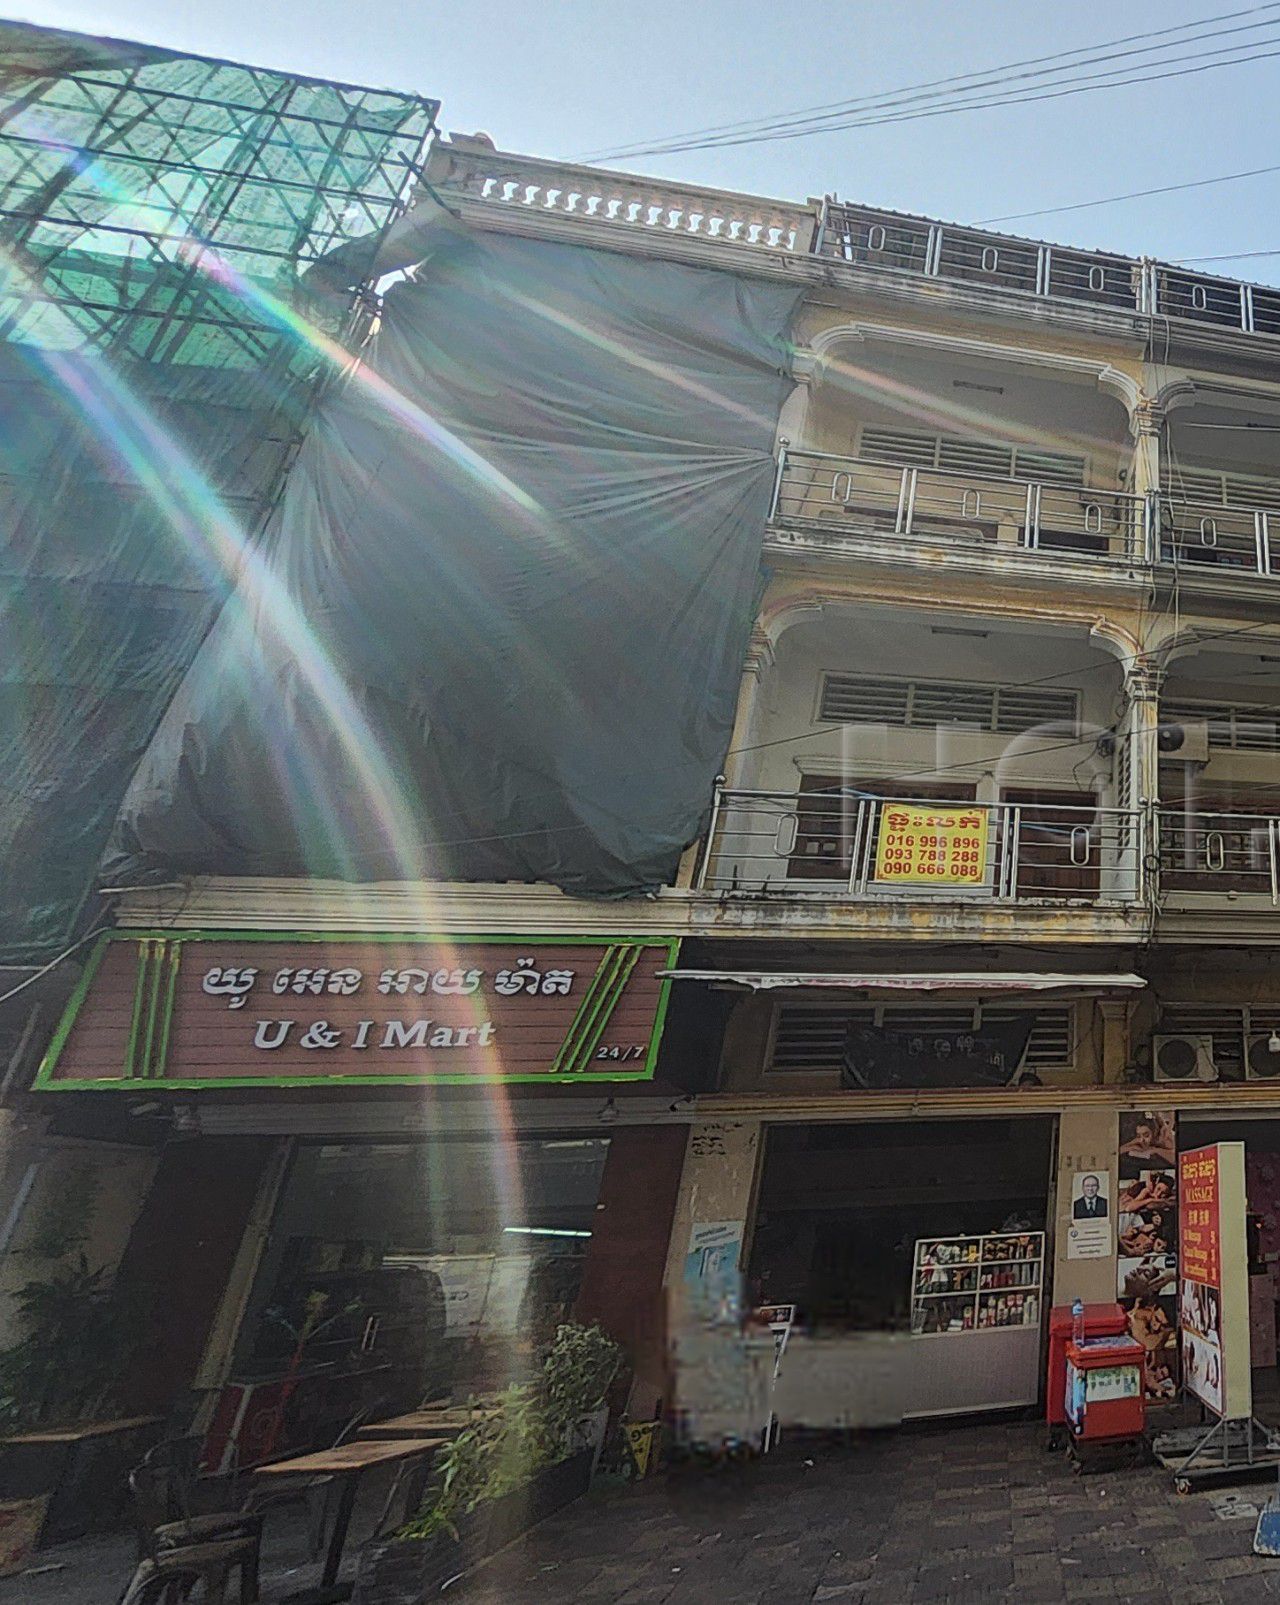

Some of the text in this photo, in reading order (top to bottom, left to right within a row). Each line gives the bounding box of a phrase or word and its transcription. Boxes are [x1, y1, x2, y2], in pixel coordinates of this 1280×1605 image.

[888, 810, 981, 832] ផ្ទះលក់
[886, 834, 980, 849] 016 996 896
[884, 848, 979, 862] 093 788 288
[883, 862, 978, 876] 090 666 088
[202, 966, 258, 1008] យូ
[377, 966, 485, 996] អាយ
[494, 957, 576, 996] ម៉ាត
[252, 1018, 497, 1050] U & I Mart
[597, 1045, 645, 1061] 24/7
